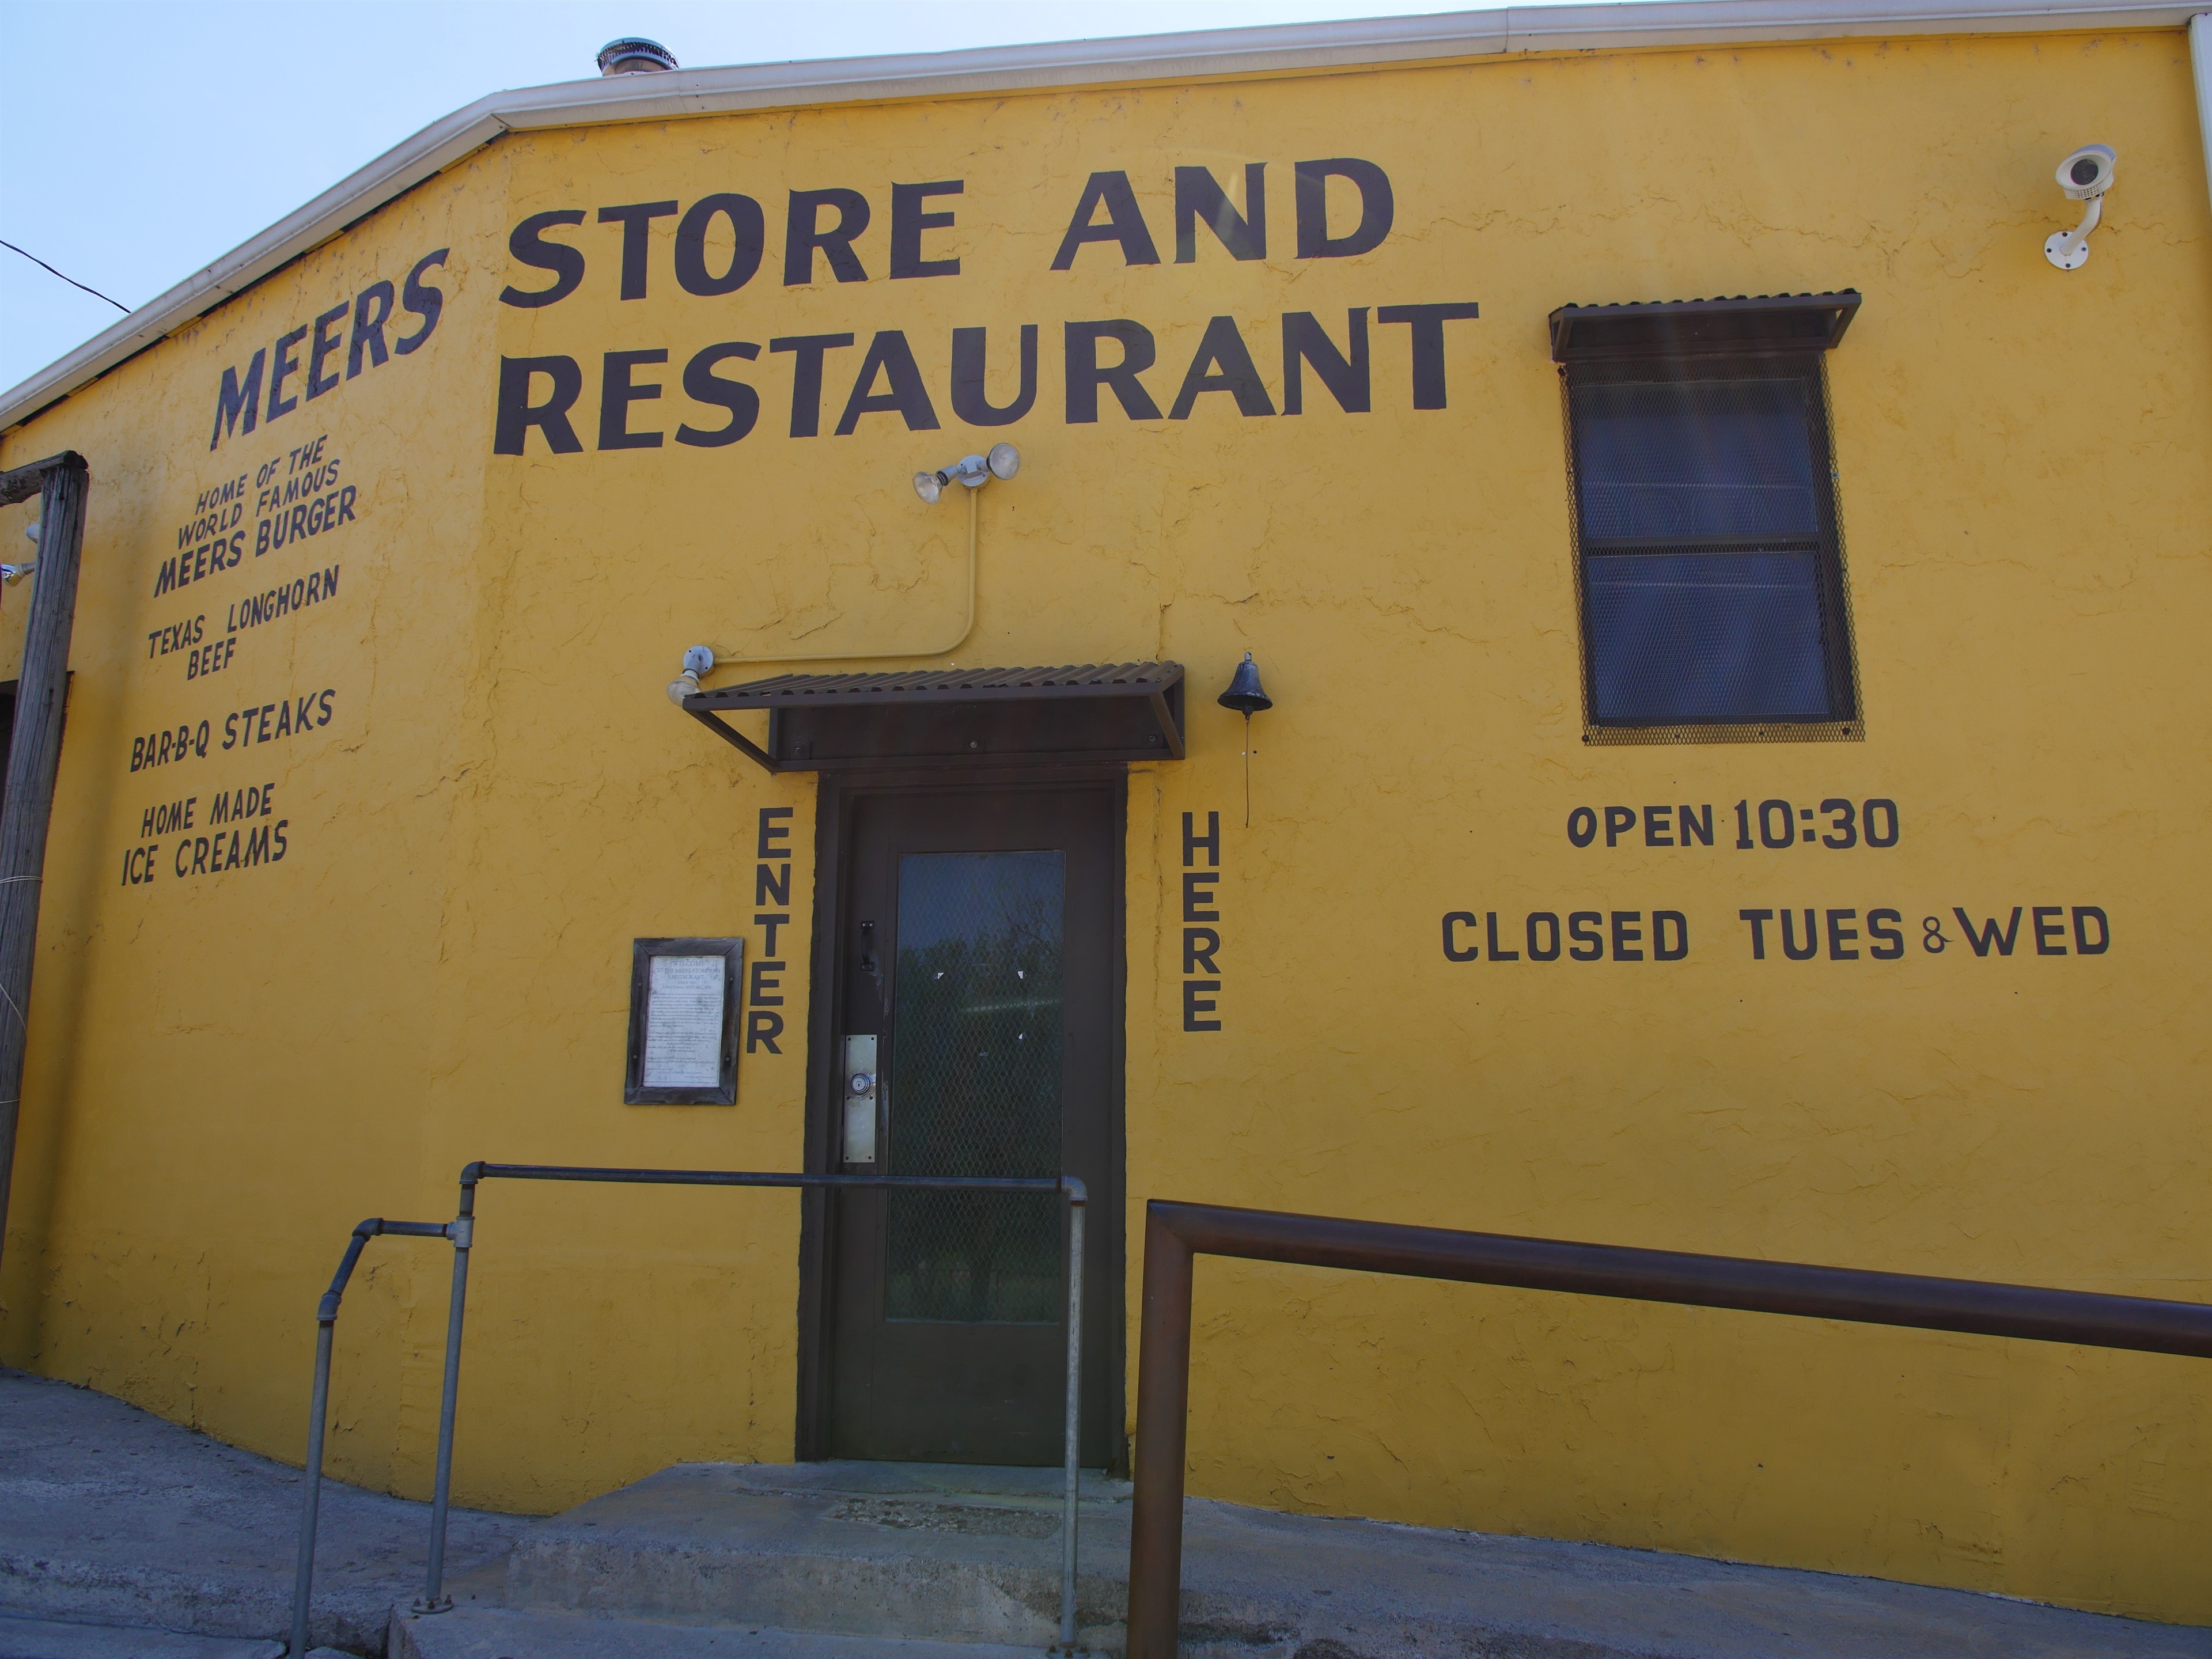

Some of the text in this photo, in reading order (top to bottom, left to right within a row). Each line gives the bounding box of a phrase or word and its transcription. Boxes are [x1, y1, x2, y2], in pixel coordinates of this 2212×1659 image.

[499, 158, 1394, 308] STORE AND
[210, 247, 450, 452] MEERS
[493, 302, 1479, 456] RESTAURANT
[178, 458, 340, 550] WORLD FAMOUS
[195, 434, 328, 515] HOME OF THE
[154, 484, 357, 598] MEERS BURGER
[148, 565, 340, 659] TEXAS LONGHORN
[187, 638, 236, 681] BEEF
[130, 688, 336, 772] BAR-B-Q STEAKS
[121, 820, 288, 886] ICE CREAMS
[141, 782, 275, 838] HOME MADE
[1567, 798, 1900, 850] OPEN 10:30
[747, 807, 794, 1054] ENTER
[1182, 811, 1222, 1032] HERE
[1441, 910, 1689, 962] CLOSED
[1738, 908, 1905, 960] TUES
